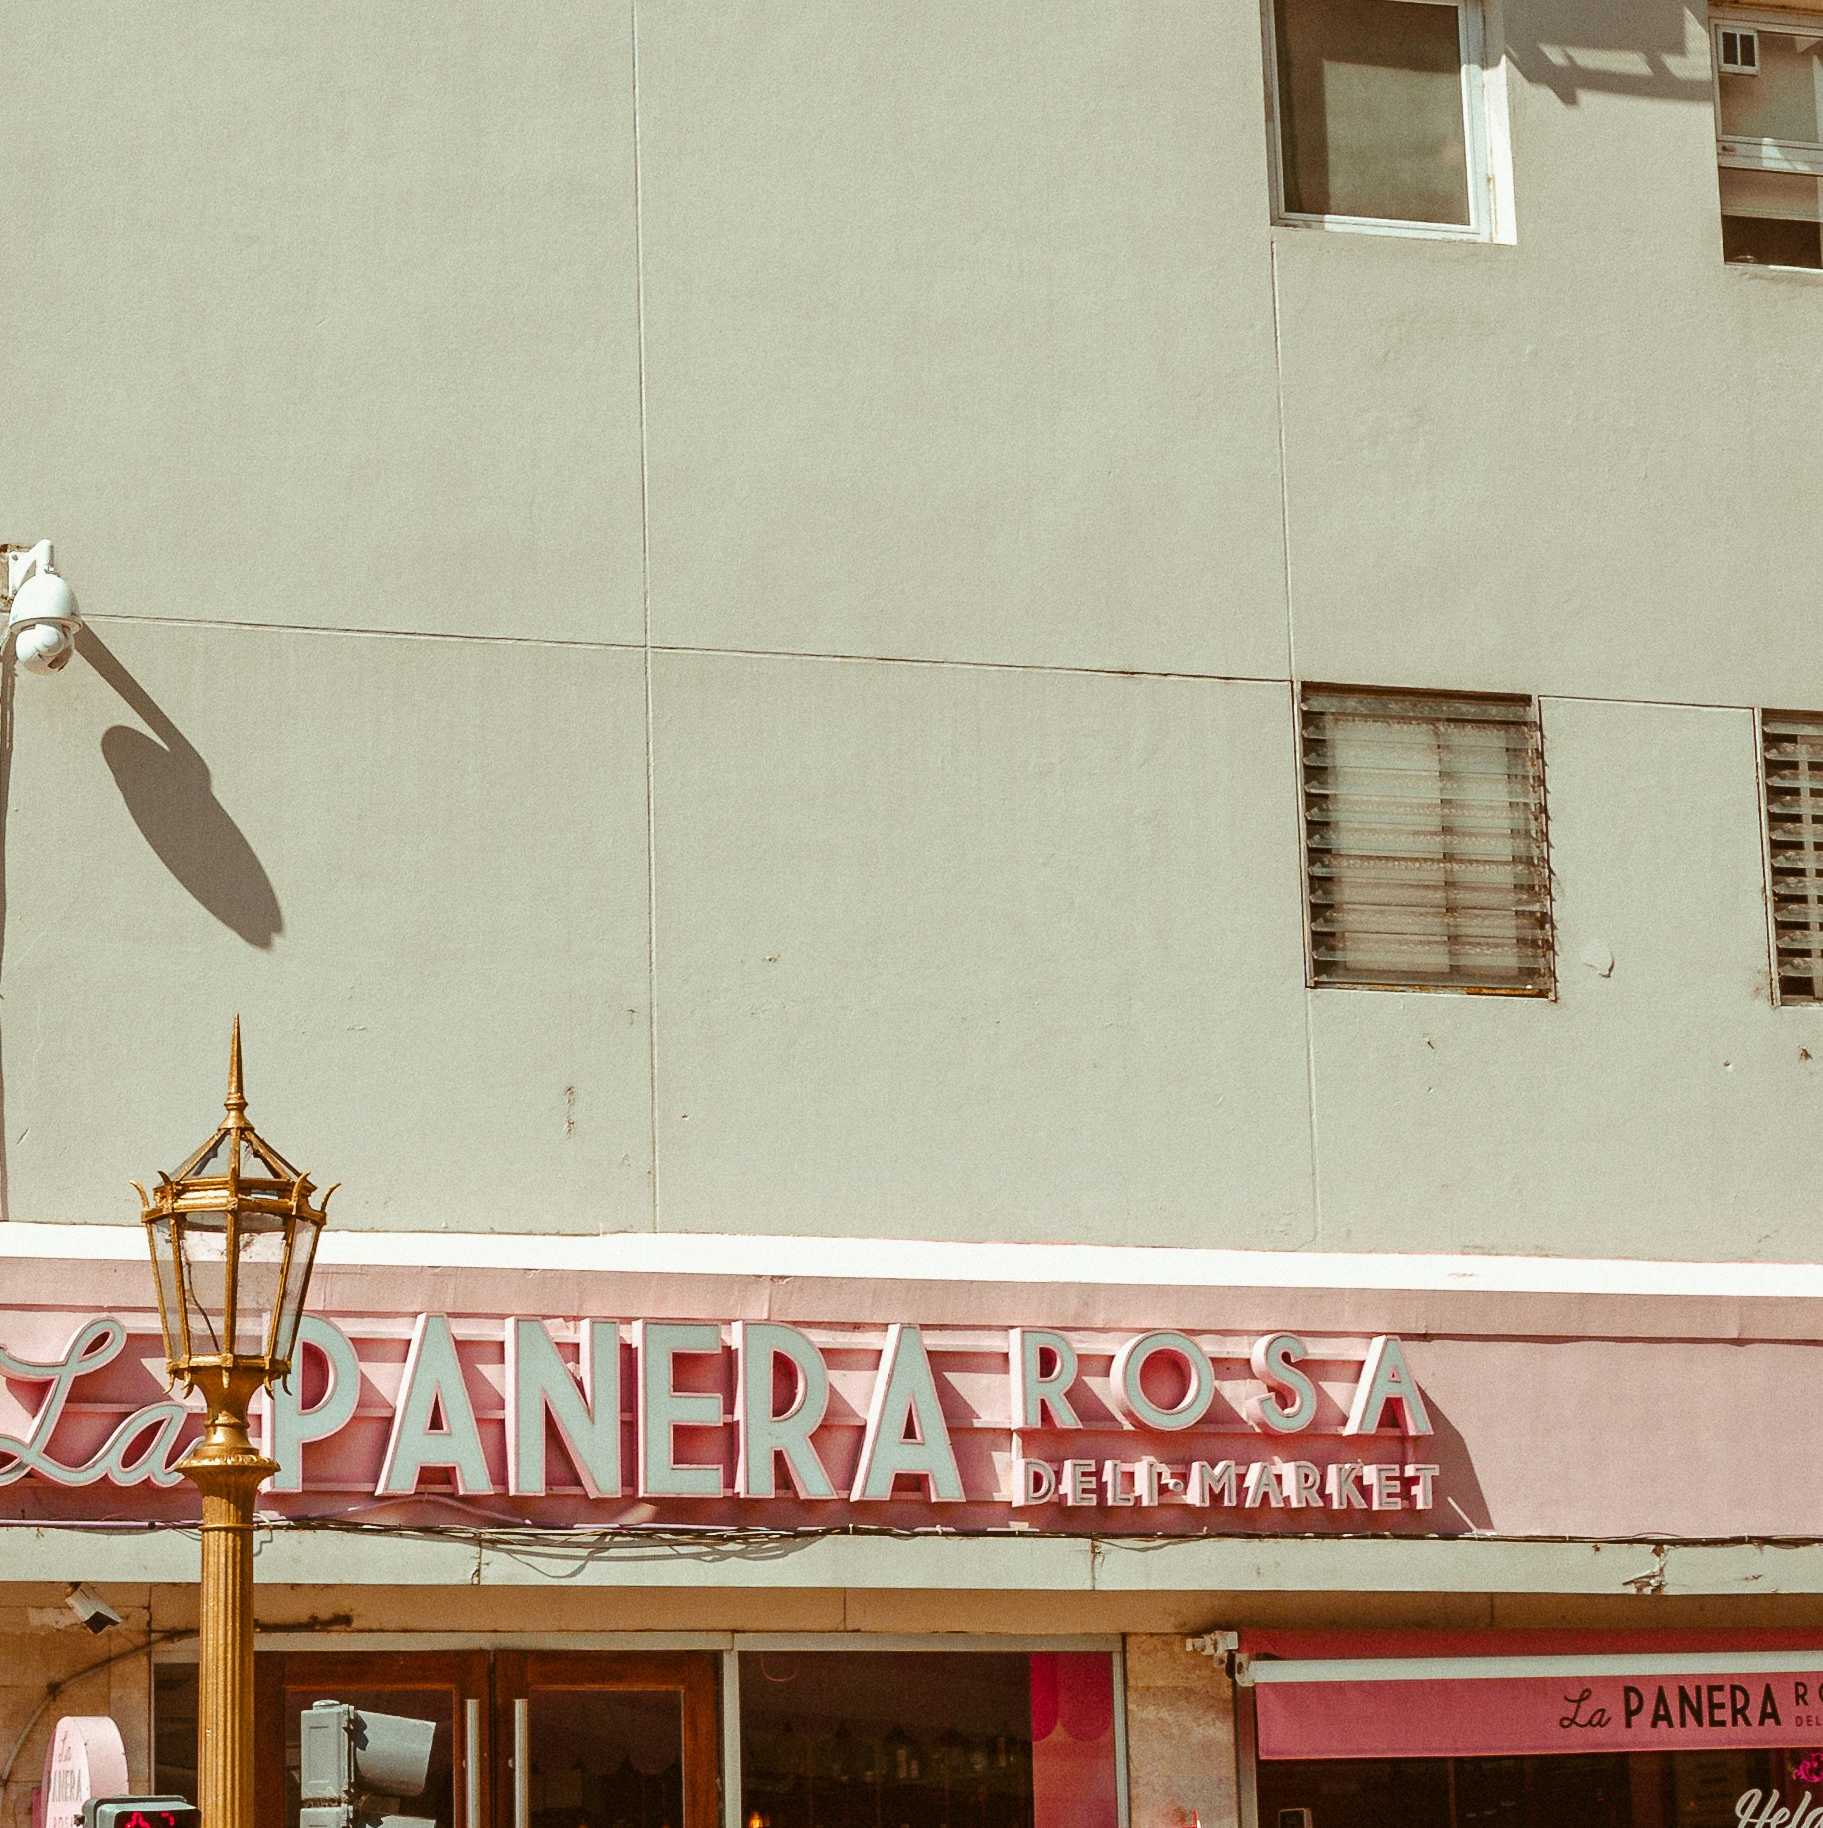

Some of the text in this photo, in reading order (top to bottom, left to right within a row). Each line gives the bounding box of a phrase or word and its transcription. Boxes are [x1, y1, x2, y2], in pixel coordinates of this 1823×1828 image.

[266, 1311, 968, 1503] PANERA
[1009, 1328, 1434, 1437] ROSA
[1559, 1680, 1823, 1730] La PANERA R
